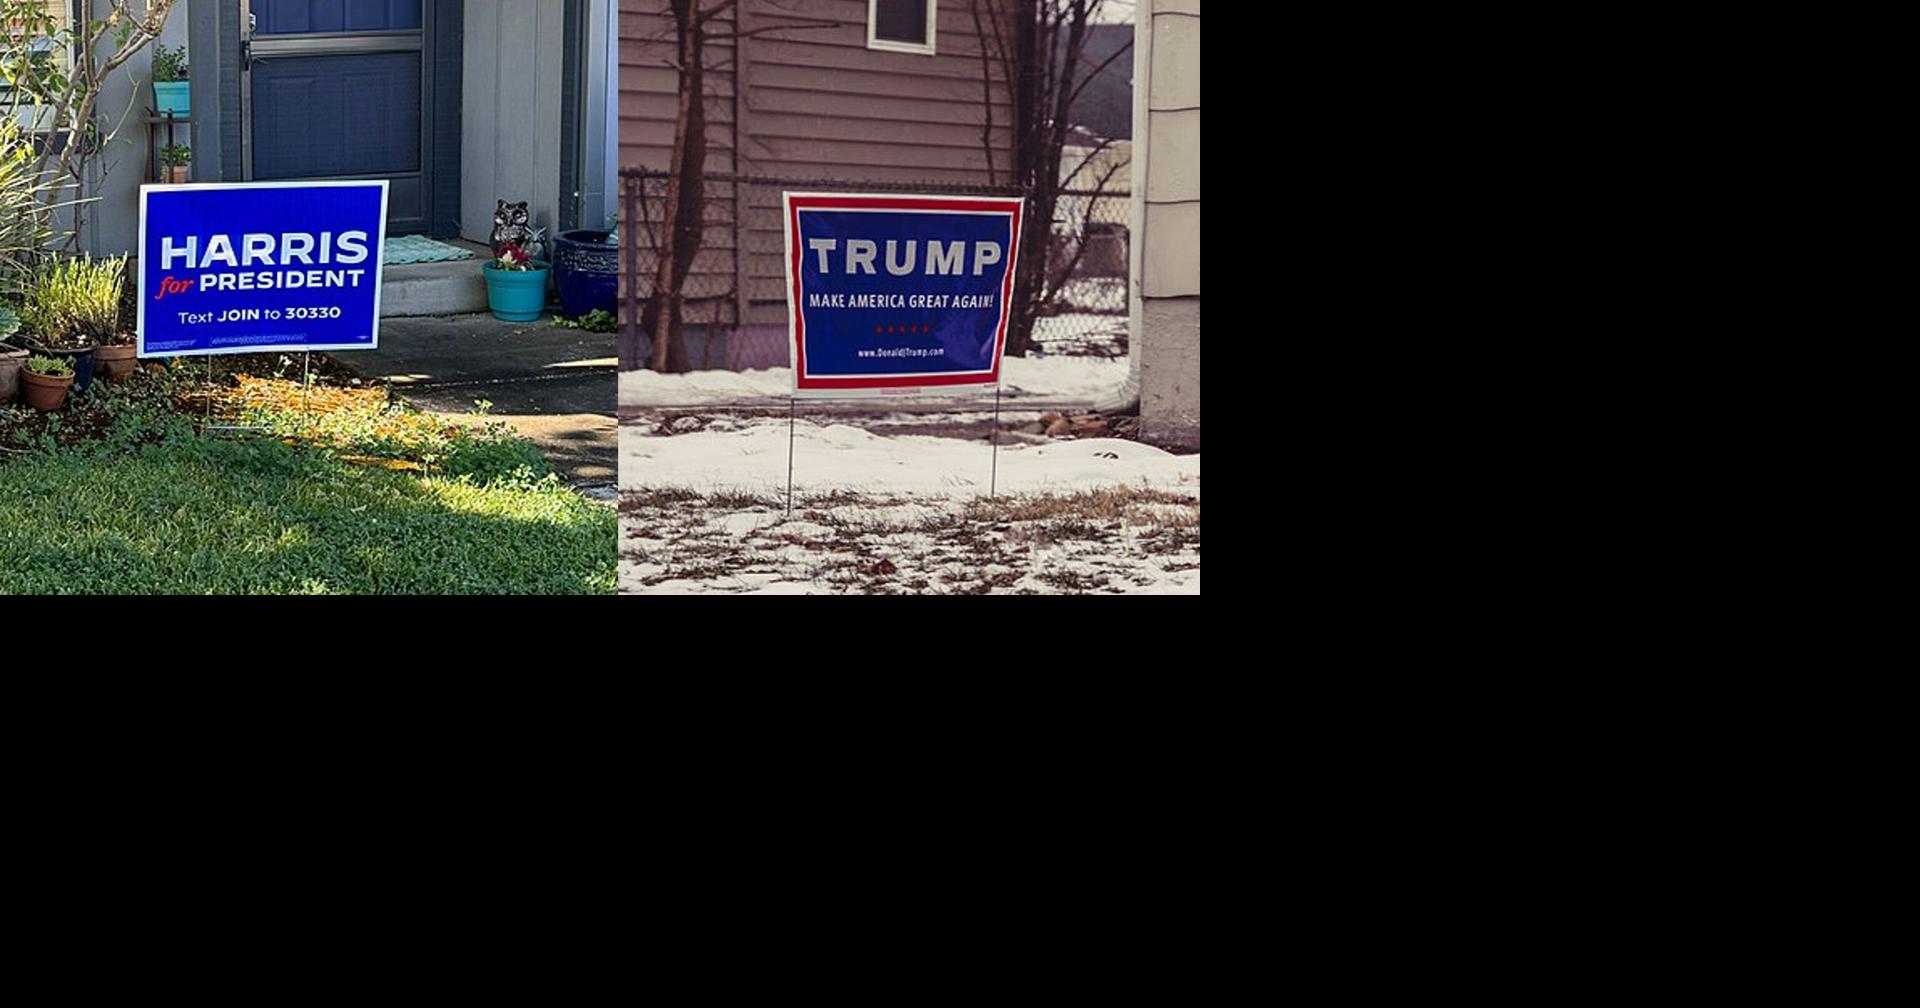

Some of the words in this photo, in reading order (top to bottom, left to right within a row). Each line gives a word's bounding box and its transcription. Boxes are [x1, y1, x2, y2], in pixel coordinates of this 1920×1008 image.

[161, 230, 369, 270] HARRIS
[808, 238, 1001, 276] TRUMP
[155, 275, 194, 300] for
[200, 269, 365, 292] PRESIDENT
[178, 311, 213, 324] Text
[217, 309, 260, 322] JOIN
[264, 308, 281, 320] to
[285, 306, 341, 319] 30330
[809, 293, 845, 308] MAKE
[848, 293, 905, 308] AMERICA
[909, 294, 949, 308] GREAT
[952, 294, 994, 308] AGAIN!
